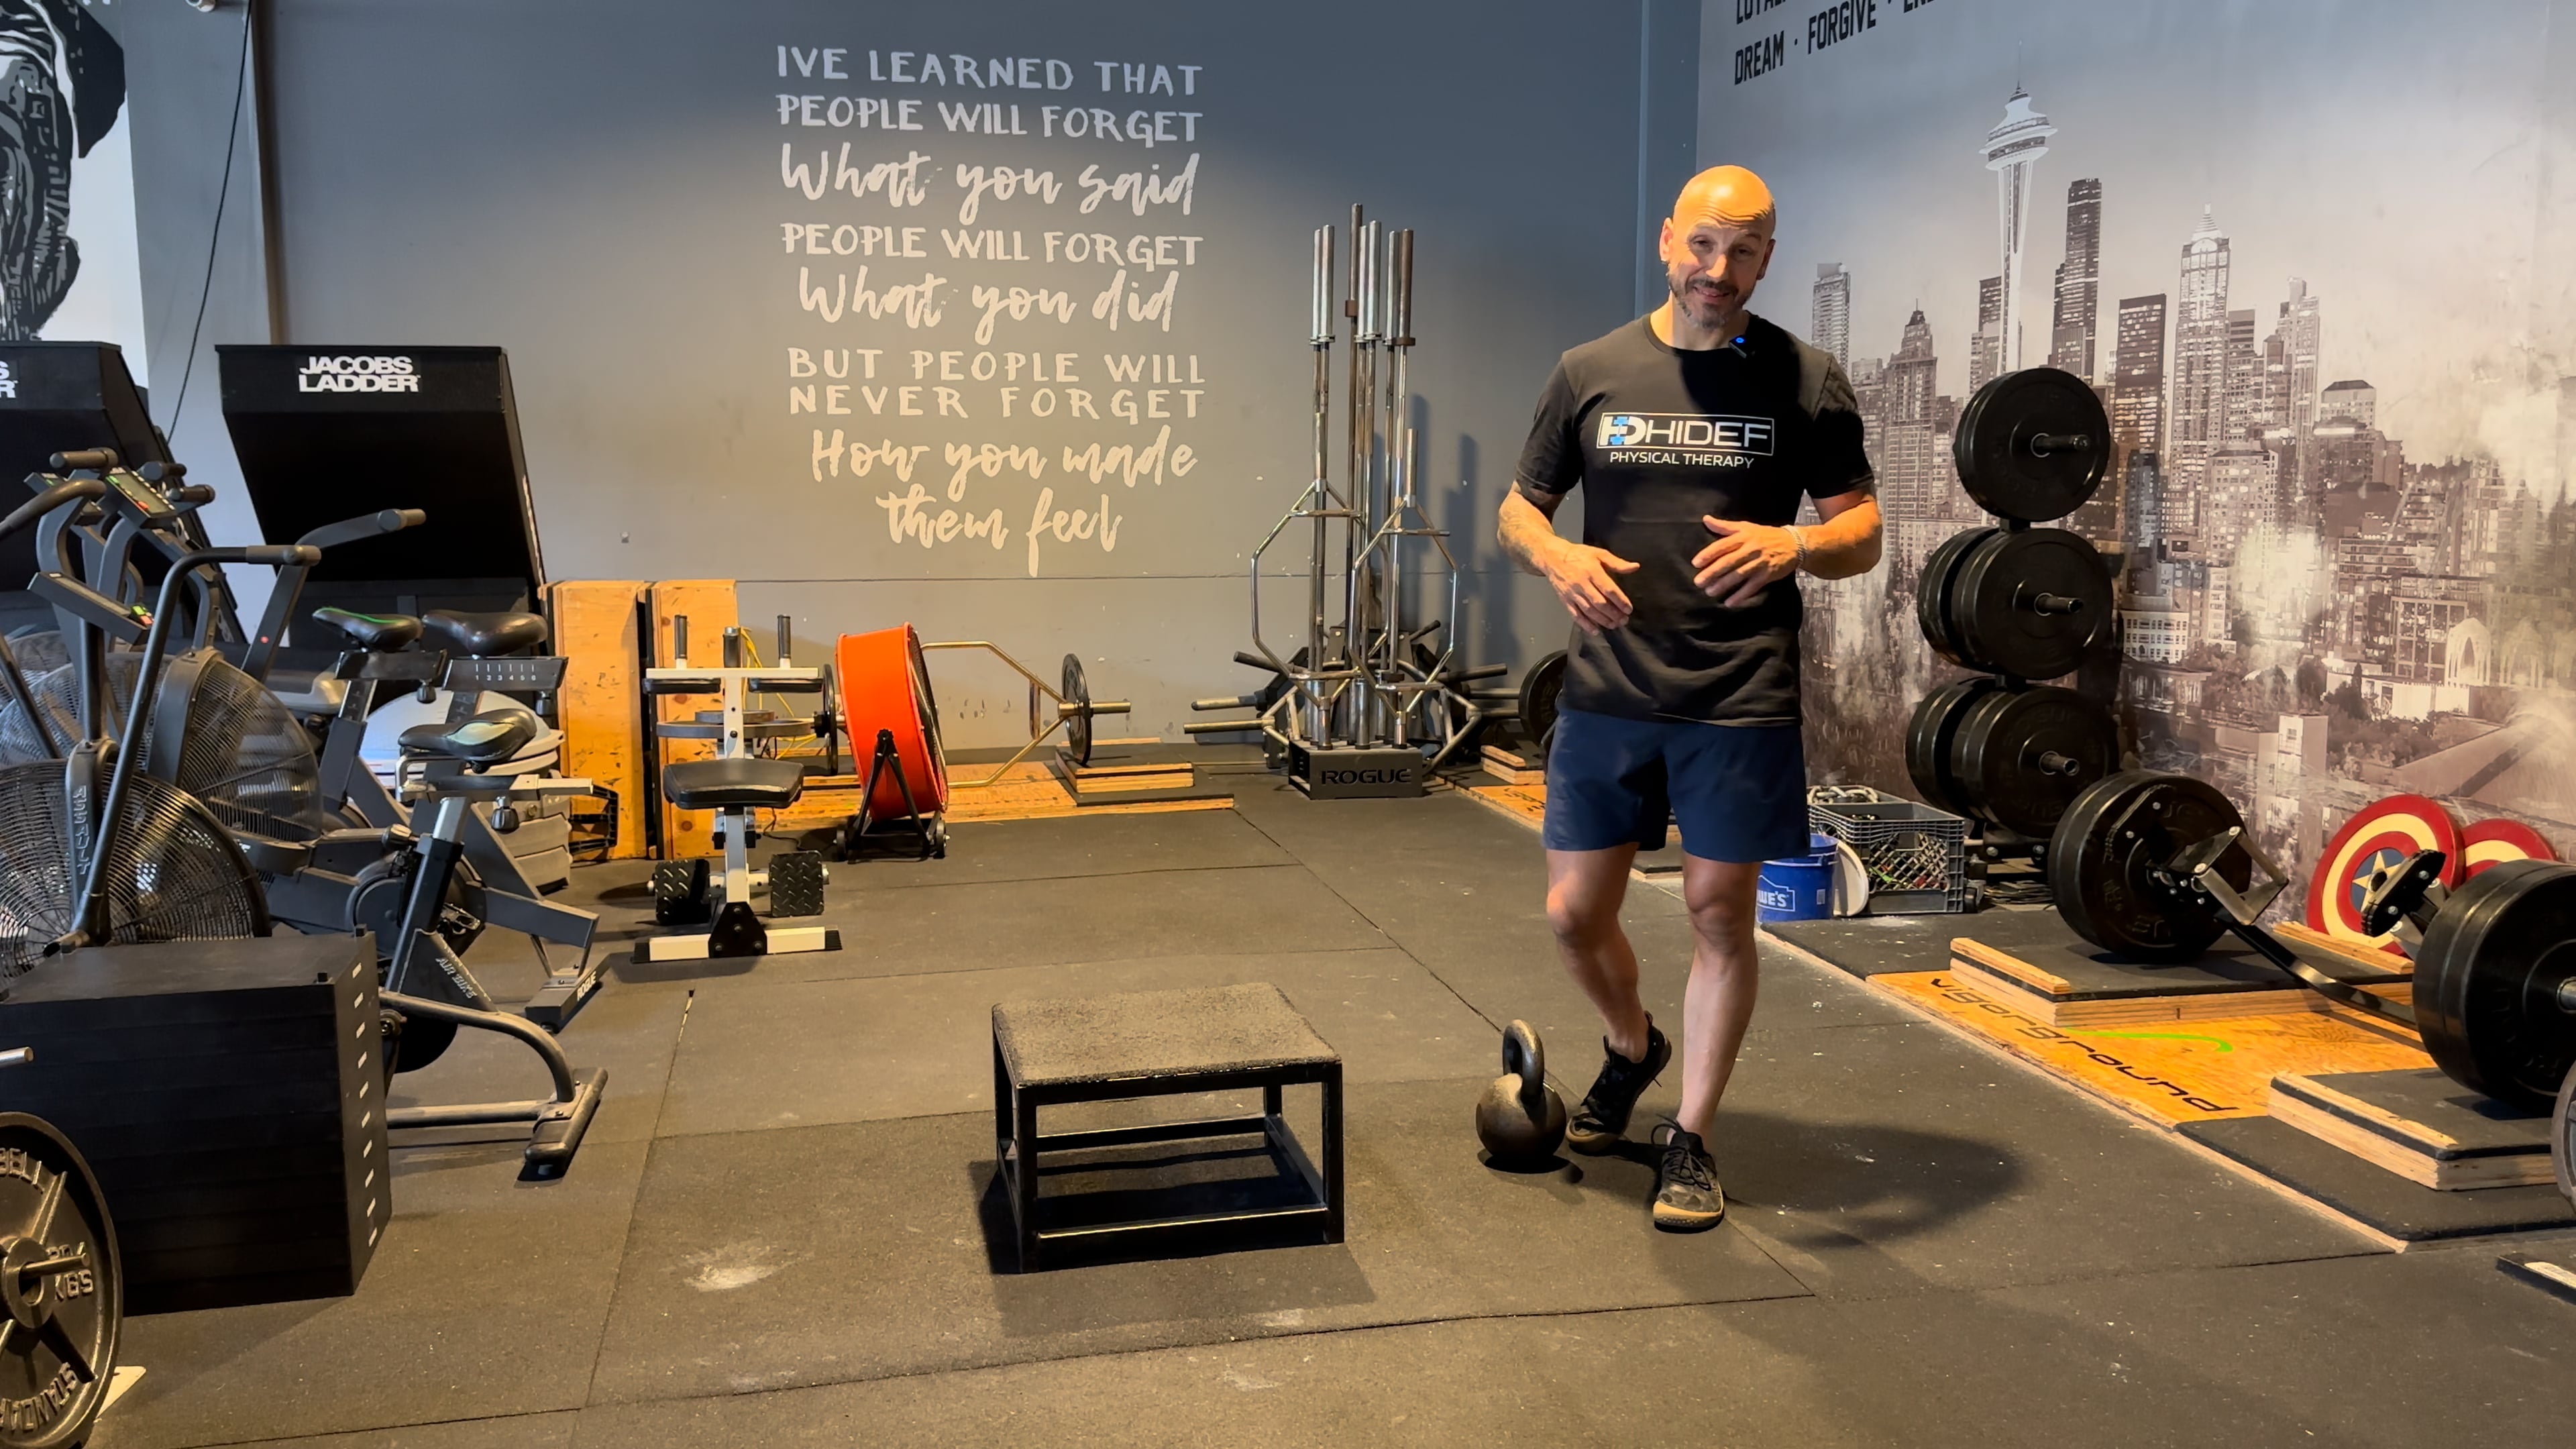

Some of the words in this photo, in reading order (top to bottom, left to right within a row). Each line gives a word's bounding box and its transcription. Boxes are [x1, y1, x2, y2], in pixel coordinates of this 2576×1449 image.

[1735, 30, 1784, 85] DREAM
[1807, 0, 1876, 54] FORGIVE
[777, 45, 849, 80] IVE
[869, 50, 1074, 90] LEARNED
[1094, 61, 1203, 97] THAT
[775, 94, 924, 131] PEOPLE
[938, 101, 1028, 135] WILL
[1042, 105, 1203, 148] FORGET
[782, 142, 931, 208] What
[956, 163, 1063, 225] you
[1078, 153, 1200, 216] said
[780, 223, 927, 258] PEOPLE
[941, 229, 1030, 262] WILL
[1043, 231, 1203, 272] FORGET
[798, 265, 948, 329] What
[971, 284, 1077, 345] you
[1091, 268, 1179, 332] did
[298, 374, 420, 392] LADDER
[299, 356, 413, 374] JACOBS
[788, 347, 883, 379] BUT
[909, 350, 1080, 382] PEOPLE
[1104, 354, 1205, 384] WILL
[790, 384, 969, 419] NEVER
[1000, 386, 1205, 425] FORGET
[1645, 419, 1772, 447] HIDEF
[812, 429, 930, 482] How
[945, 441, 1047, 503] you
[1063, 424, 1199, 486] made
[1610, 451, 1680, 465] PHYSICAL
[1682, 453, 1755, 469] THERAPY
[875, 483, 1010, 549] them
[1025, 487, 1122, 578] feel
[1321, 769, 1411, 785] ROGUE
[1757, 890, 1787, 908] WE'S
